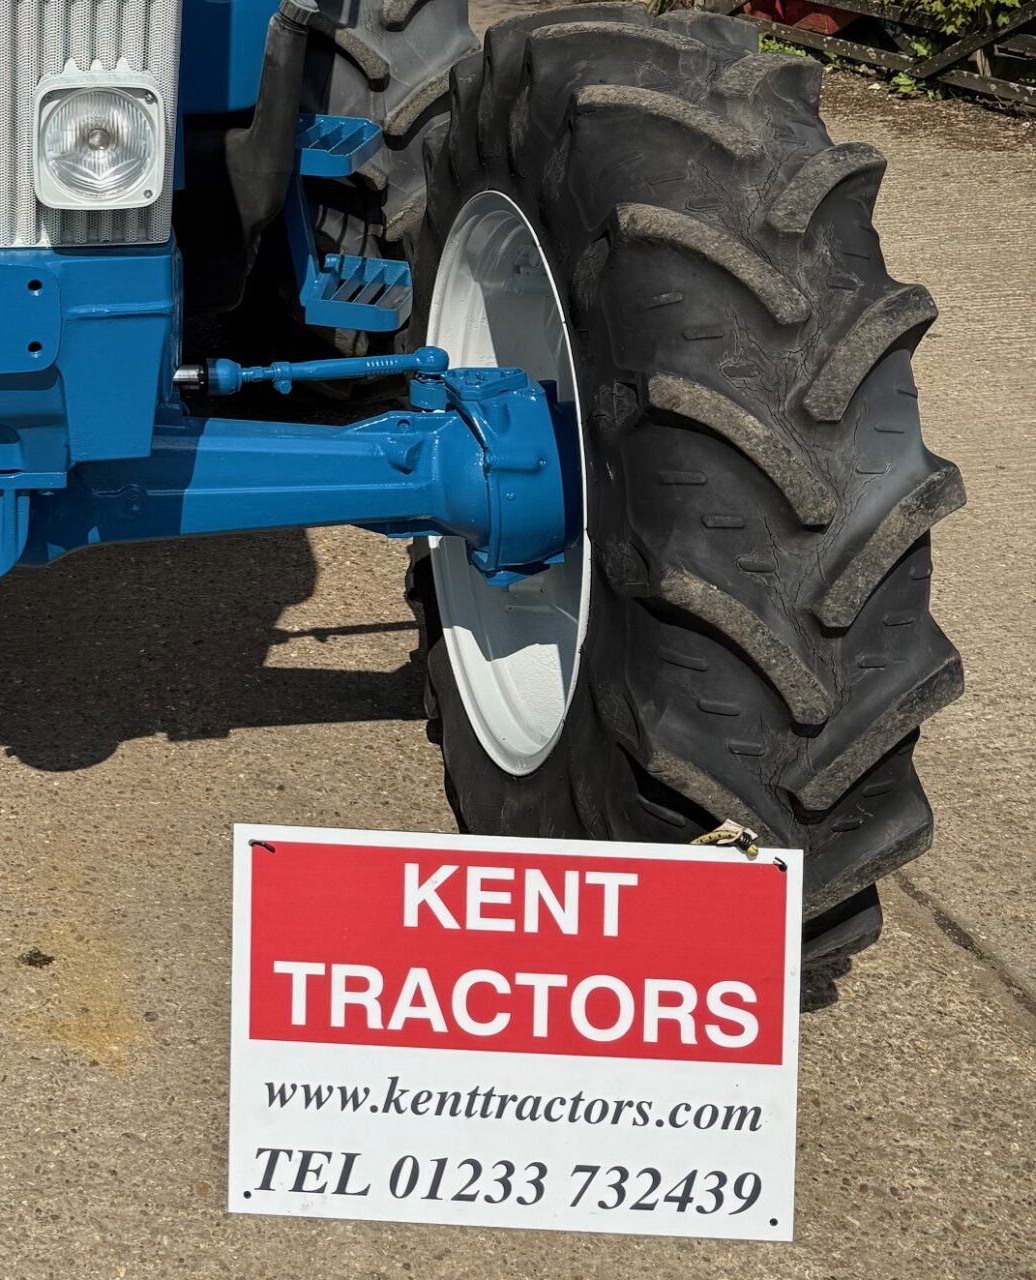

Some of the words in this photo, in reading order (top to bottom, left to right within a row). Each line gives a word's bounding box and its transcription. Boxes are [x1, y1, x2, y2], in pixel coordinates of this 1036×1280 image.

[403, 863, 639, 937] KENT
[273, 961, 759, 1049] TRACTORS
[264, 1076, 763, 1132] www.kenttractors.com
[254, 1147, 372, 1198] TEL
[388, 1155, 549, 1206] 01233
[568, 1164, 763, 1216] 732439
